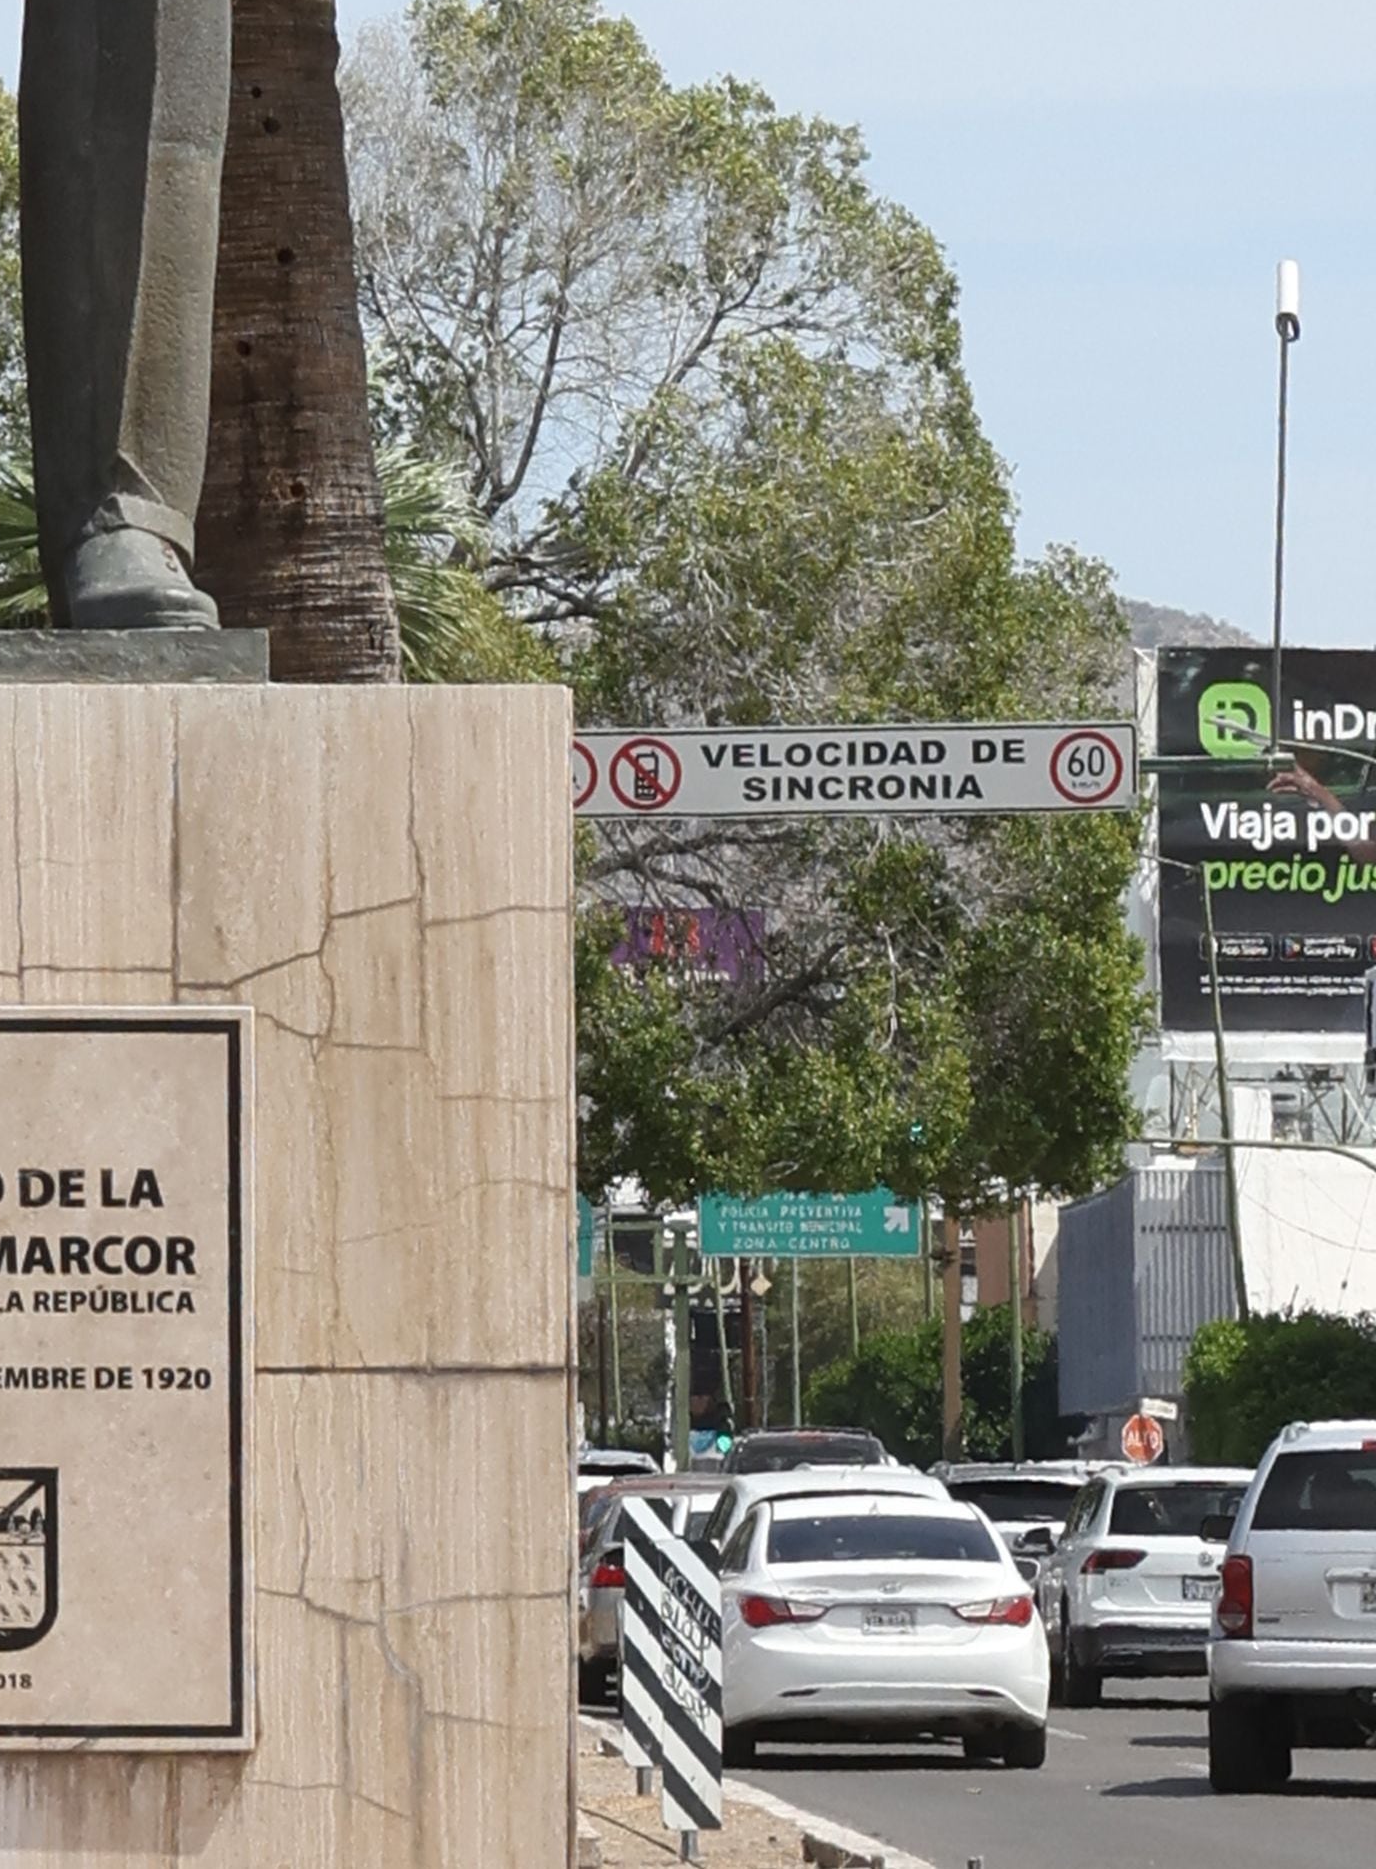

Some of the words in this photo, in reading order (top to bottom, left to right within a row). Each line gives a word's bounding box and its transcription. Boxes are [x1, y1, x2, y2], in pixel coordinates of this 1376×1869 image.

[701, 740, 946, 768] VELOCIDAD
[972, 739, 1026, 764] DE
[1067, 745, 1105, 777] 60
[743, 774, 983, 802] SINCRONIA
[1200, 802, 1297, 851] Viaja
[1306, 809, 1376, 852] por
[1205, 853, 1326, 892] precio
[18, 1168, 86, 1208] DE
[100, 1169, 164, 1208] LA
[721, 1205, 769, 1218] POLICIA
[779, 1205, 863, 1218] PREVENTIVA
[717, 1220, 726, 1233] Y
[732, 1220, 794, 1233] TRANSITO
[799, 1220, 863, 1234] MUNICIPAL
[732, 1237, 778, 1250] ZONA
[788, 1237, 852, 1250] CENTRO
[33, 1284, 195, 1314] REPÚBLICA
[94, 1366, 133, 1390] DE
[141, 1367, 211, 1390] 1920
